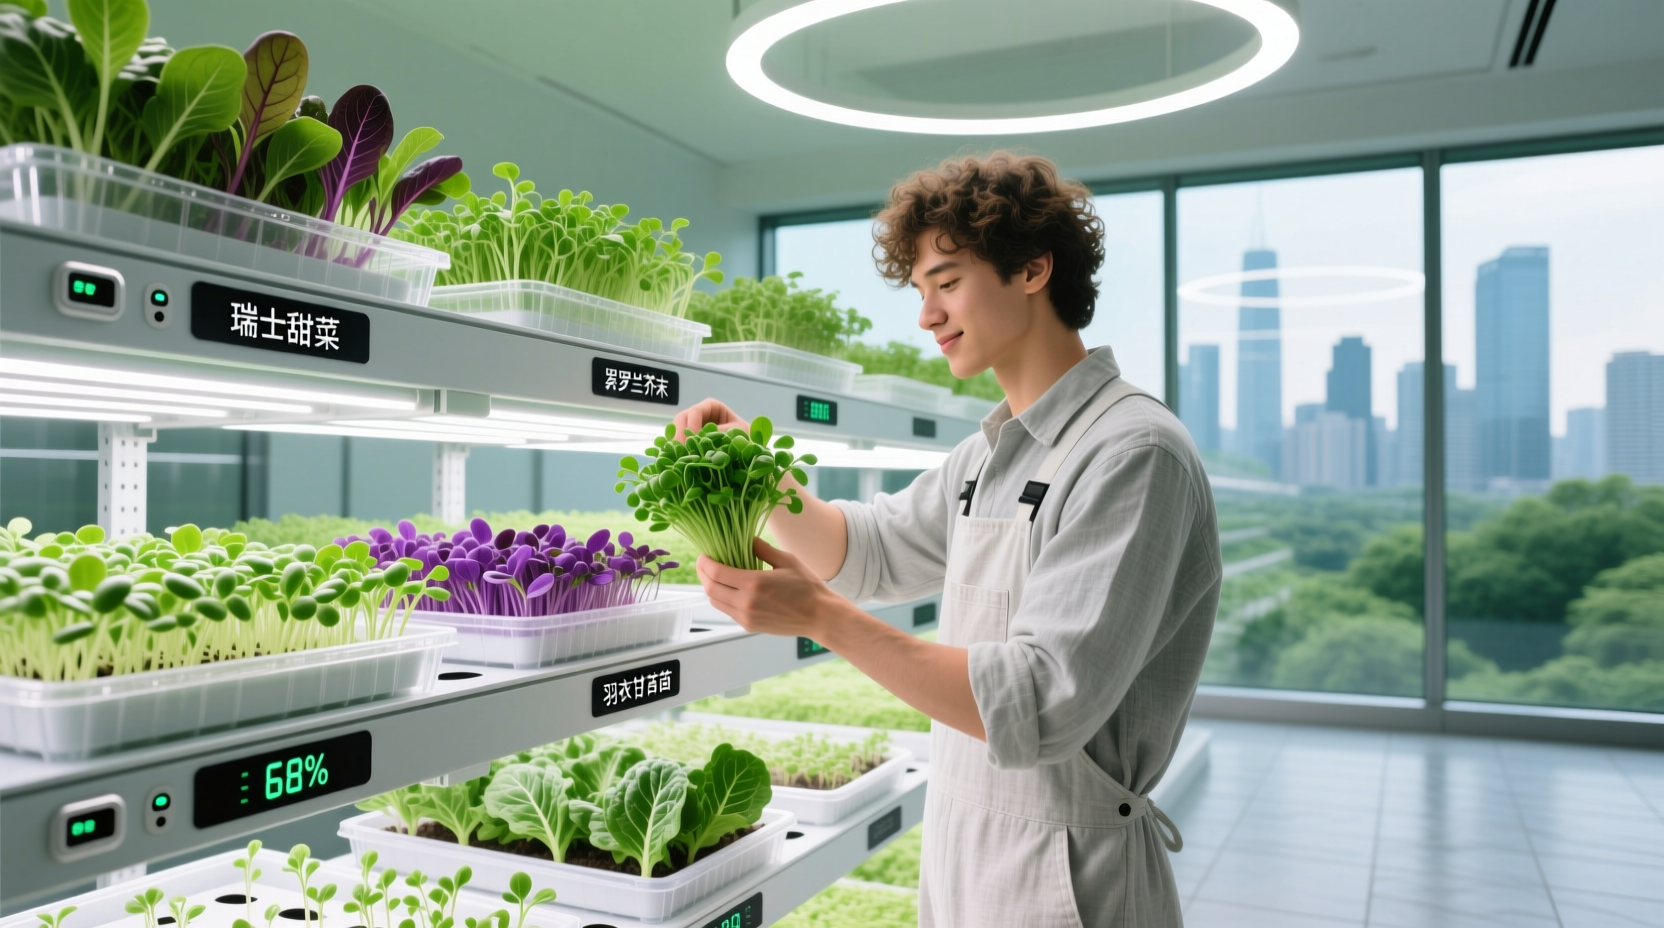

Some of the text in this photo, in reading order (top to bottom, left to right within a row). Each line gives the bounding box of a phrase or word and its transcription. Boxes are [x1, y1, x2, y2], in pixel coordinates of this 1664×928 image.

[230, 301, 340, 351] 瑞士甜菜
[265, 752, 329, 800] 68%
